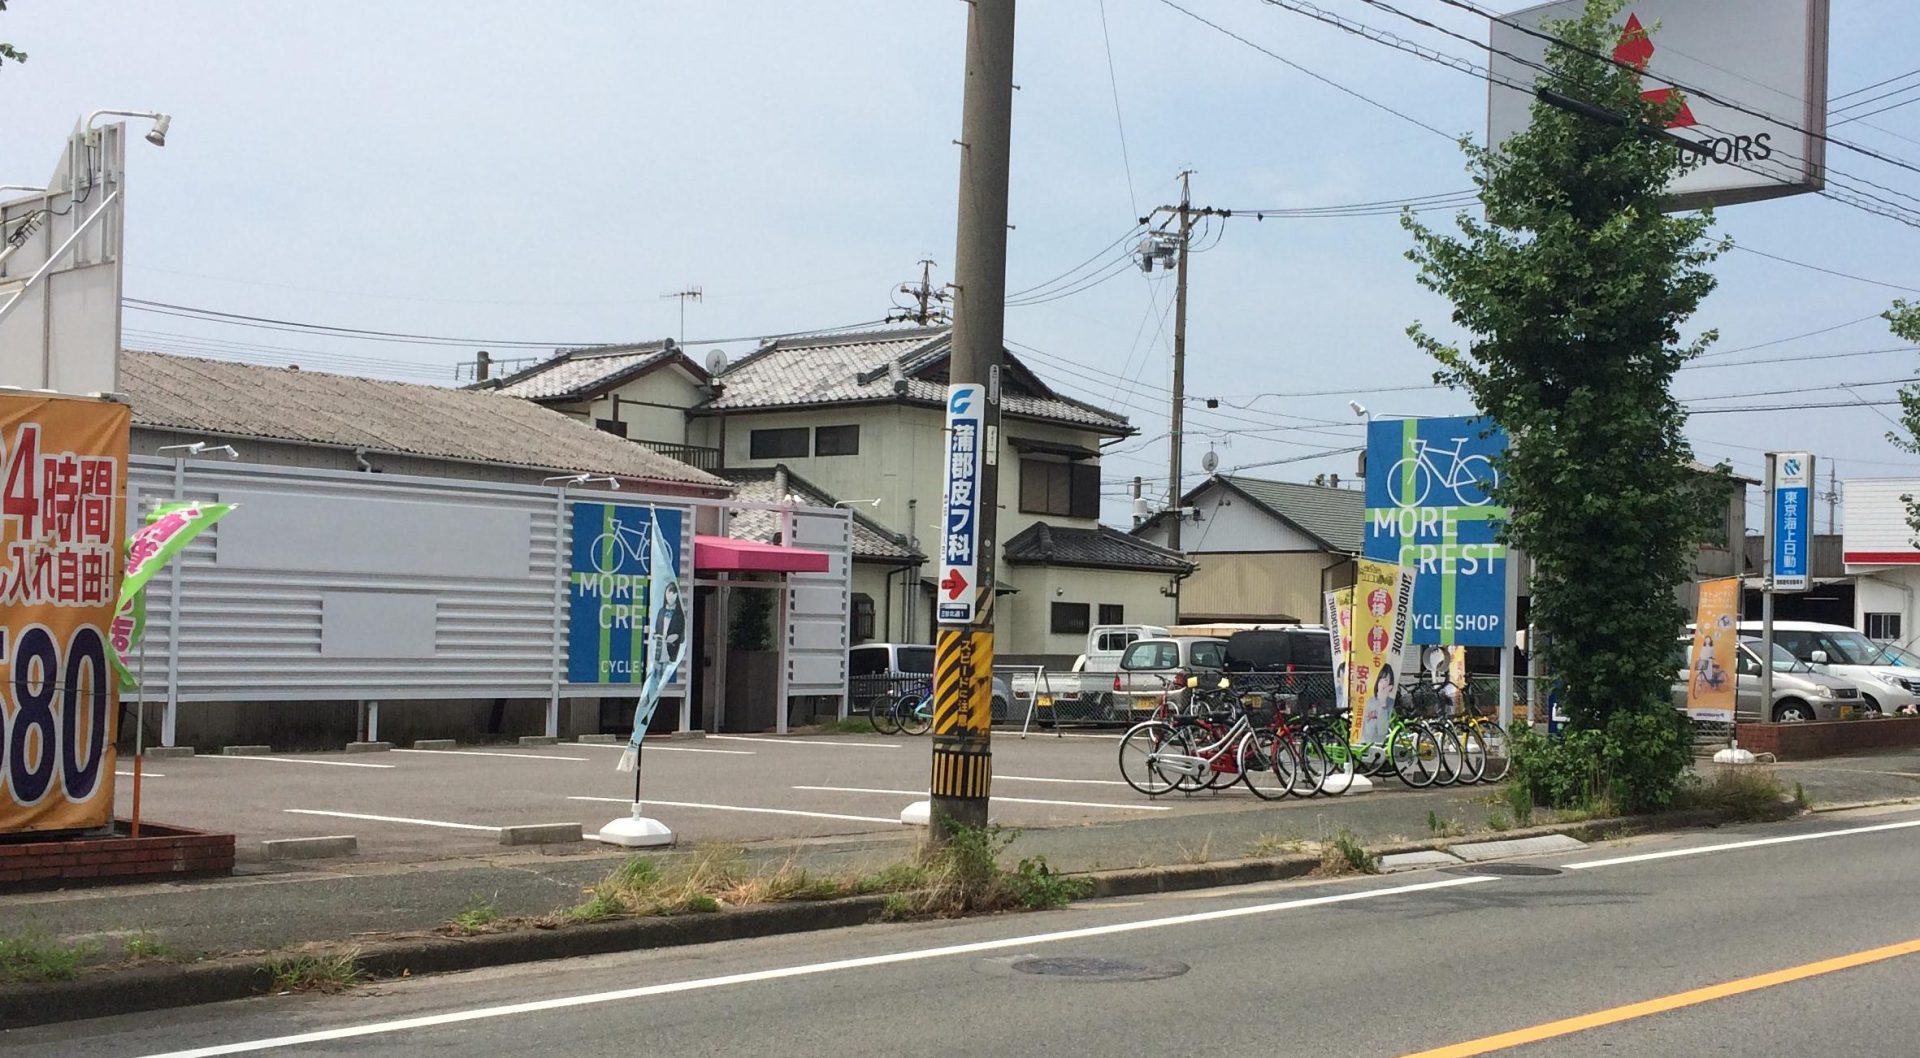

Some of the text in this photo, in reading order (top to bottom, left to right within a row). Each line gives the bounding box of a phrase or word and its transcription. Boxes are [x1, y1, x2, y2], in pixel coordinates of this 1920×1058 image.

[1680, 133, 1771, 168] OTORS
[0, 428, 112, 543] 4時間
[948, 424, 975, 562] 蒲郡皮フ科
[1373, 506, 1458, 538] MORE
[1783, 491, 1798, 568] 東京海上日動
[0, 547, 110, 602] 入れ自由!
[1399, 543, 1500, 575] CREST
[580, 572, 644, 599] MORE
[599, 604, 644, 630] CRE
[1392, 572, 1412, 655] BRIDGESTONE
[1412, 614, 1500, 631] YCLESHOP
[600, 660, 645, 673] CYCLE
[0, 627, 106, 802] 80
